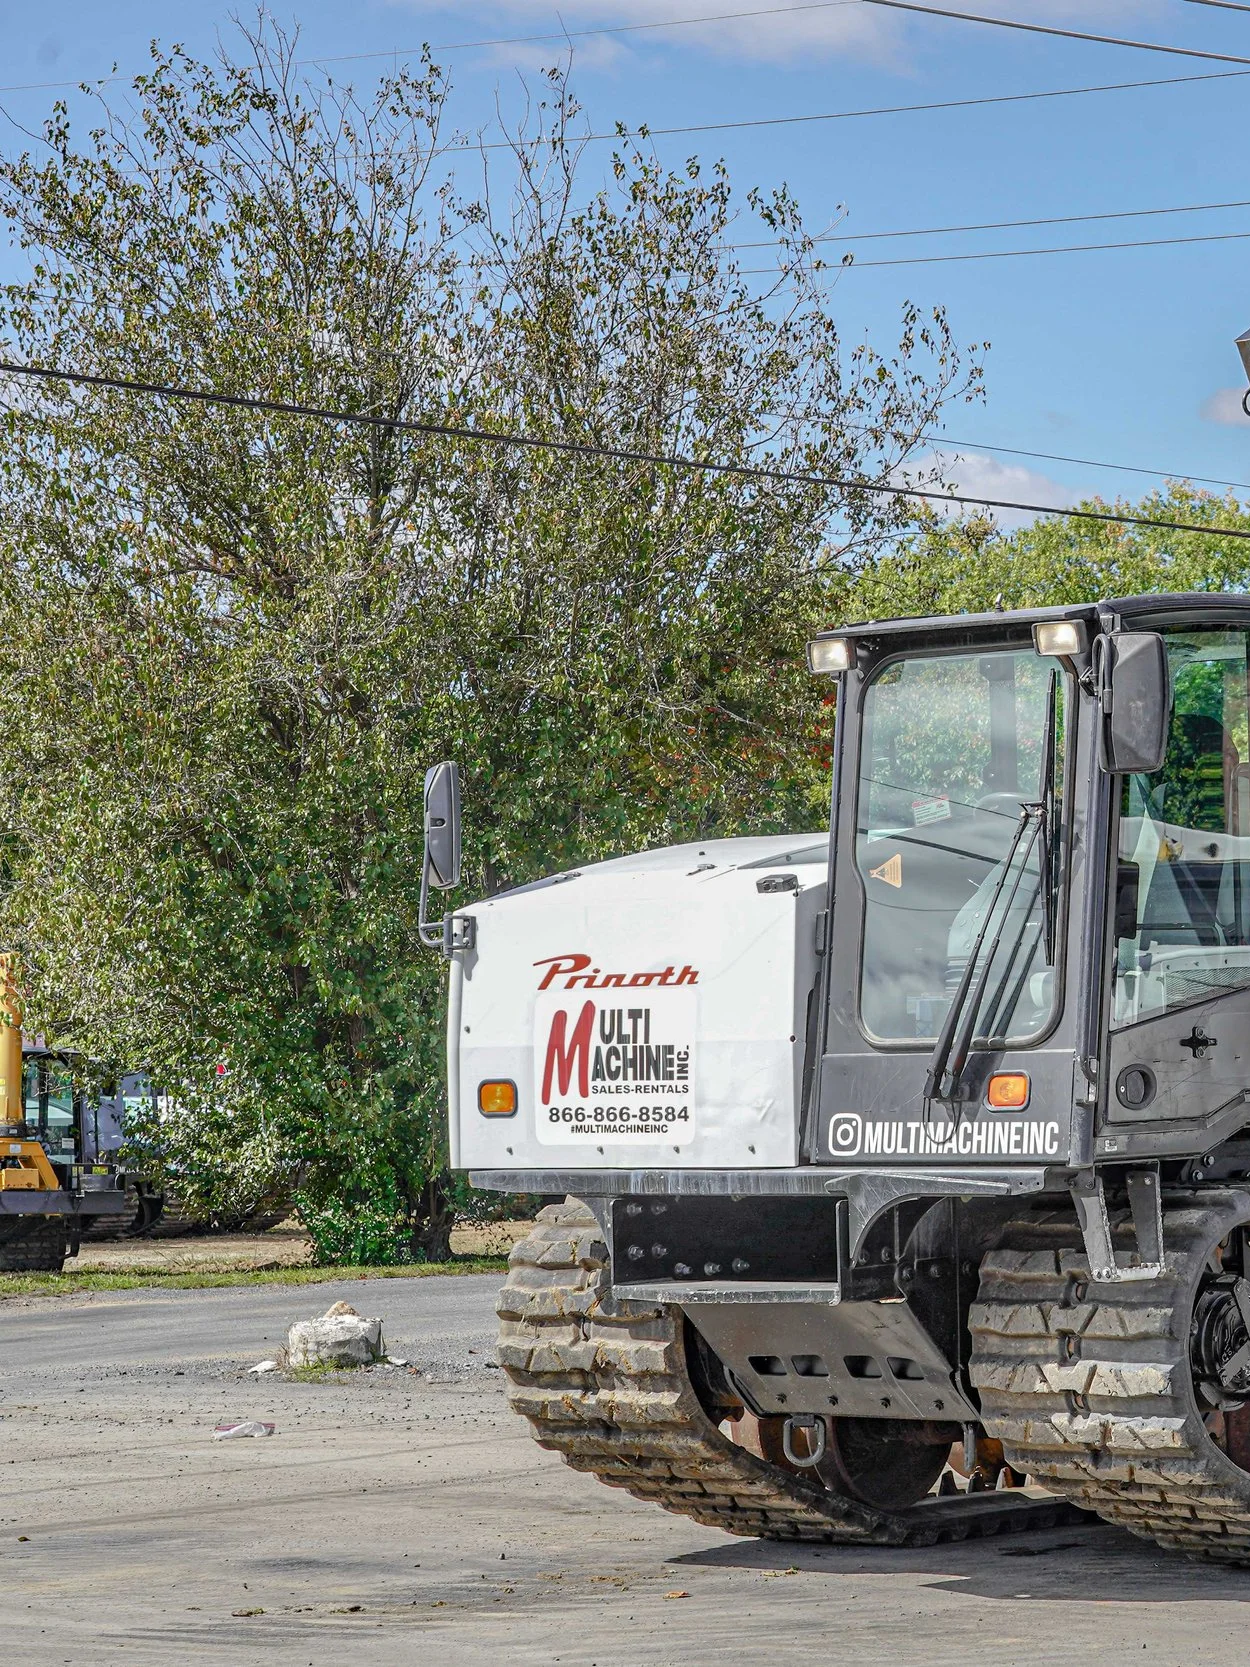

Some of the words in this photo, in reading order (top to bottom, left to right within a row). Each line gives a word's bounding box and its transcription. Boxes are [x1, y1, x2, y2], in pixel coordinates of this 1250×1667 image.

[533, 953, 699, 990] Prinoth
[676, 1045, 690, 1080] INC.
[591, 1085, 689, 1094] SALES-RENTALS
[548, 1106, 690, 1122] 866-866-8584
[570, 1124, 669, 1134] #MULTIMACHINEINC
[864, 1121, 1059, 1154] MULTIMACHINEINC
